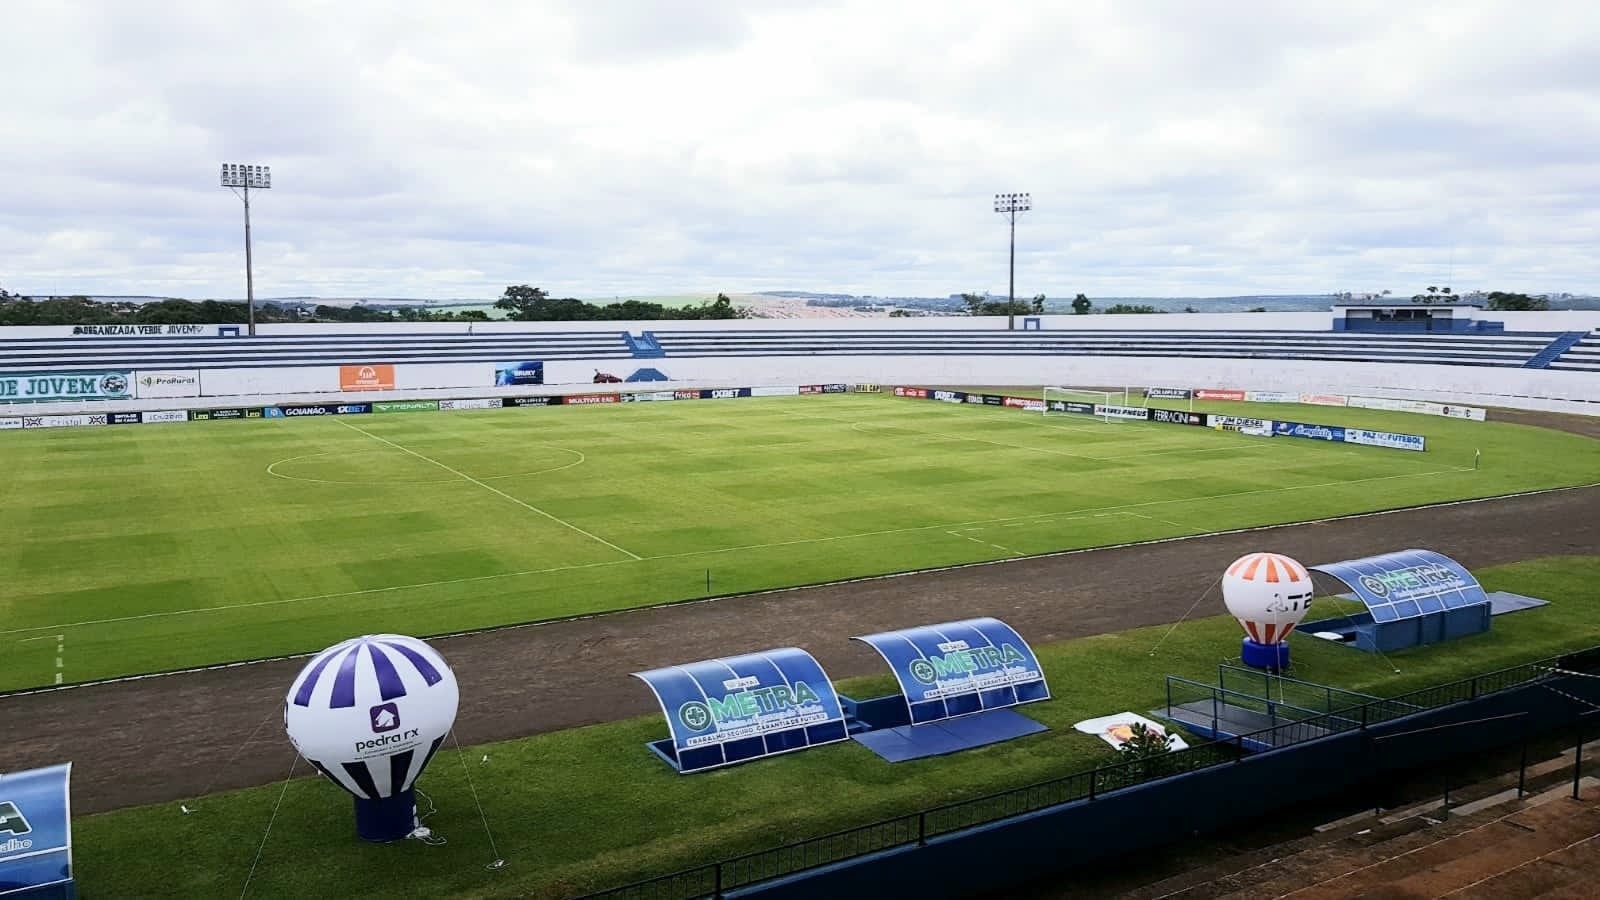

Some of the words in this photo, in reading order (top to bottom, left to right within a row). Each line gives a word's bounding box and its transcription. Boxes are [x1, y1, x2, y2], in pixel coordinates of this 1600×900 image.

[138, 325, 162, 335] VERDE
[167, 324, 196, 334] JOVEM
[156, 377, 195, 385] ProRural
[25, 378, 97, 395] JOVEM
[285, 406, 326, 416] GOIANÃO
[336, 404, 367, 414] 1XBET
[1122, 408, 1147, 417] PNEUS
[1236, 418, 1264, 428] DIESEL
[1362, 431, 1376, 439] PAZ
[1388, 434, 1422, 444] FUTEBOL
[355, 735, 401, 753] pedra
[404, 728, 419, 740] rx
